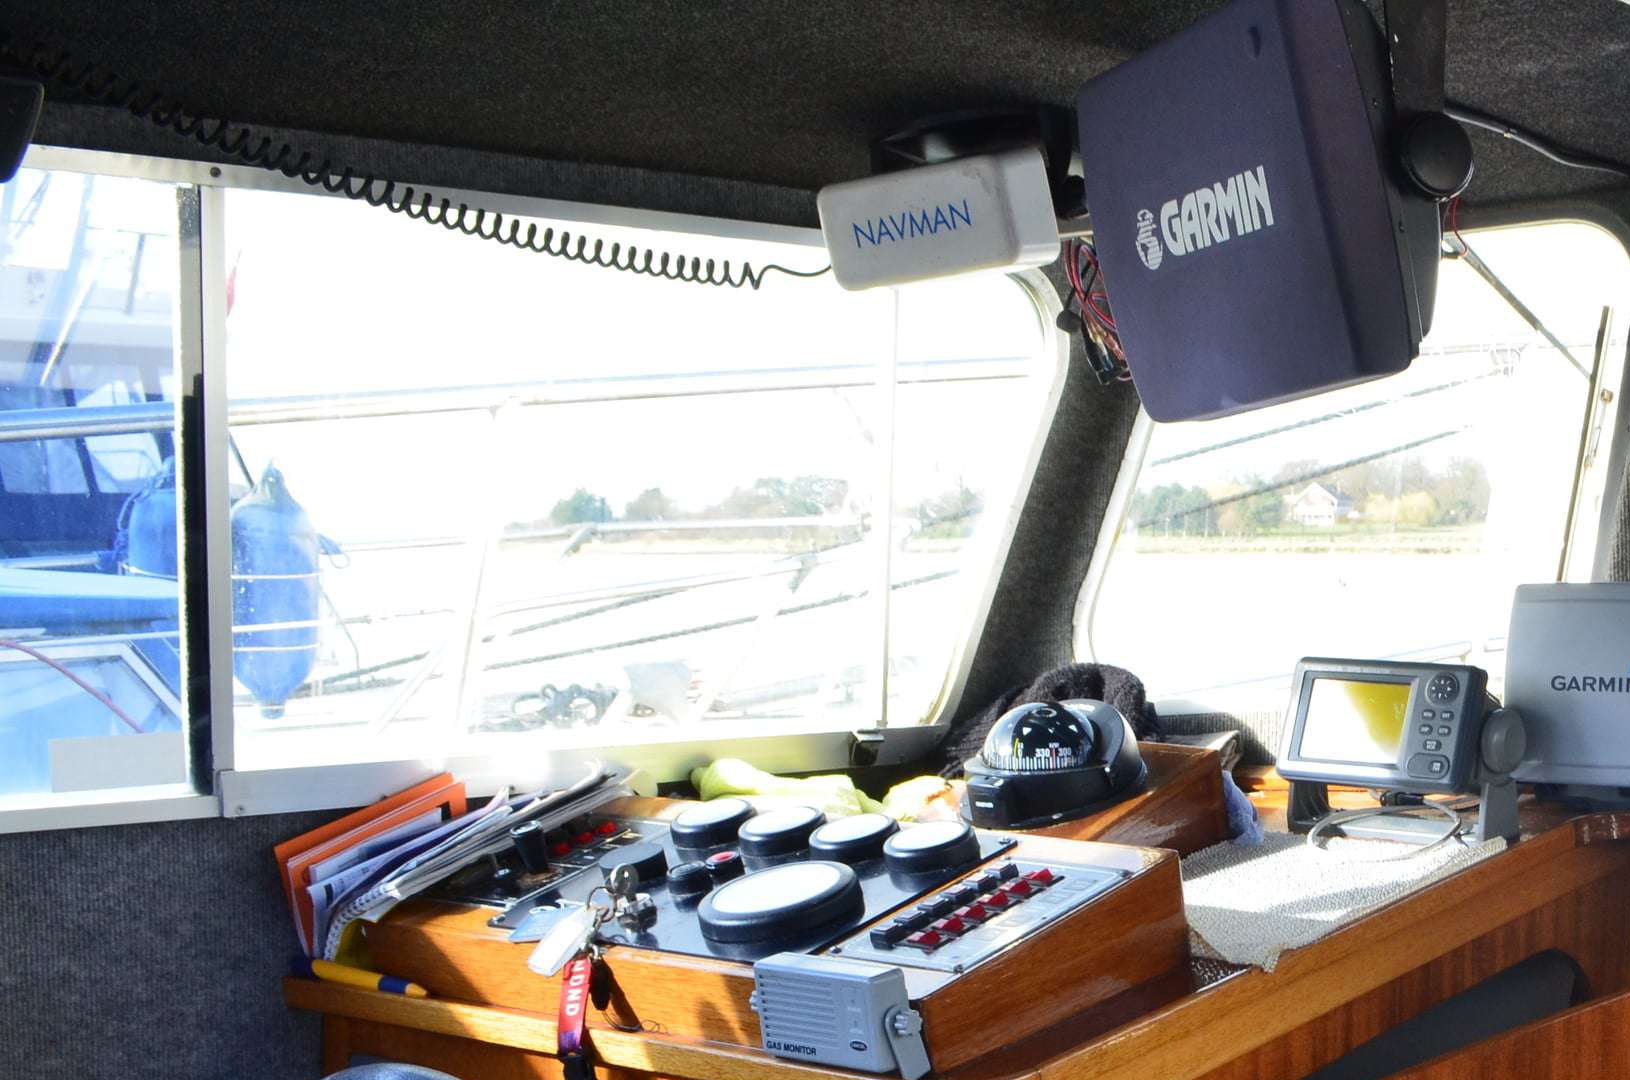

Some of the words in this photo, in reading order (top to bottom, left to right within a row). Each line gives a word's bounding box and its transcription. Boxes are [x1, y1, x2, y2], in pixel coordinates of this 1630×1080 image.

[852, 199, 973, 249] NAVMAN
[1160, 164, 1274, 256] GARMIN
[1035, 747, 1051, 758] 330
[766, 1040, 782, 1051] GAS
[783, 1043, 817, 1056] MONITOR
